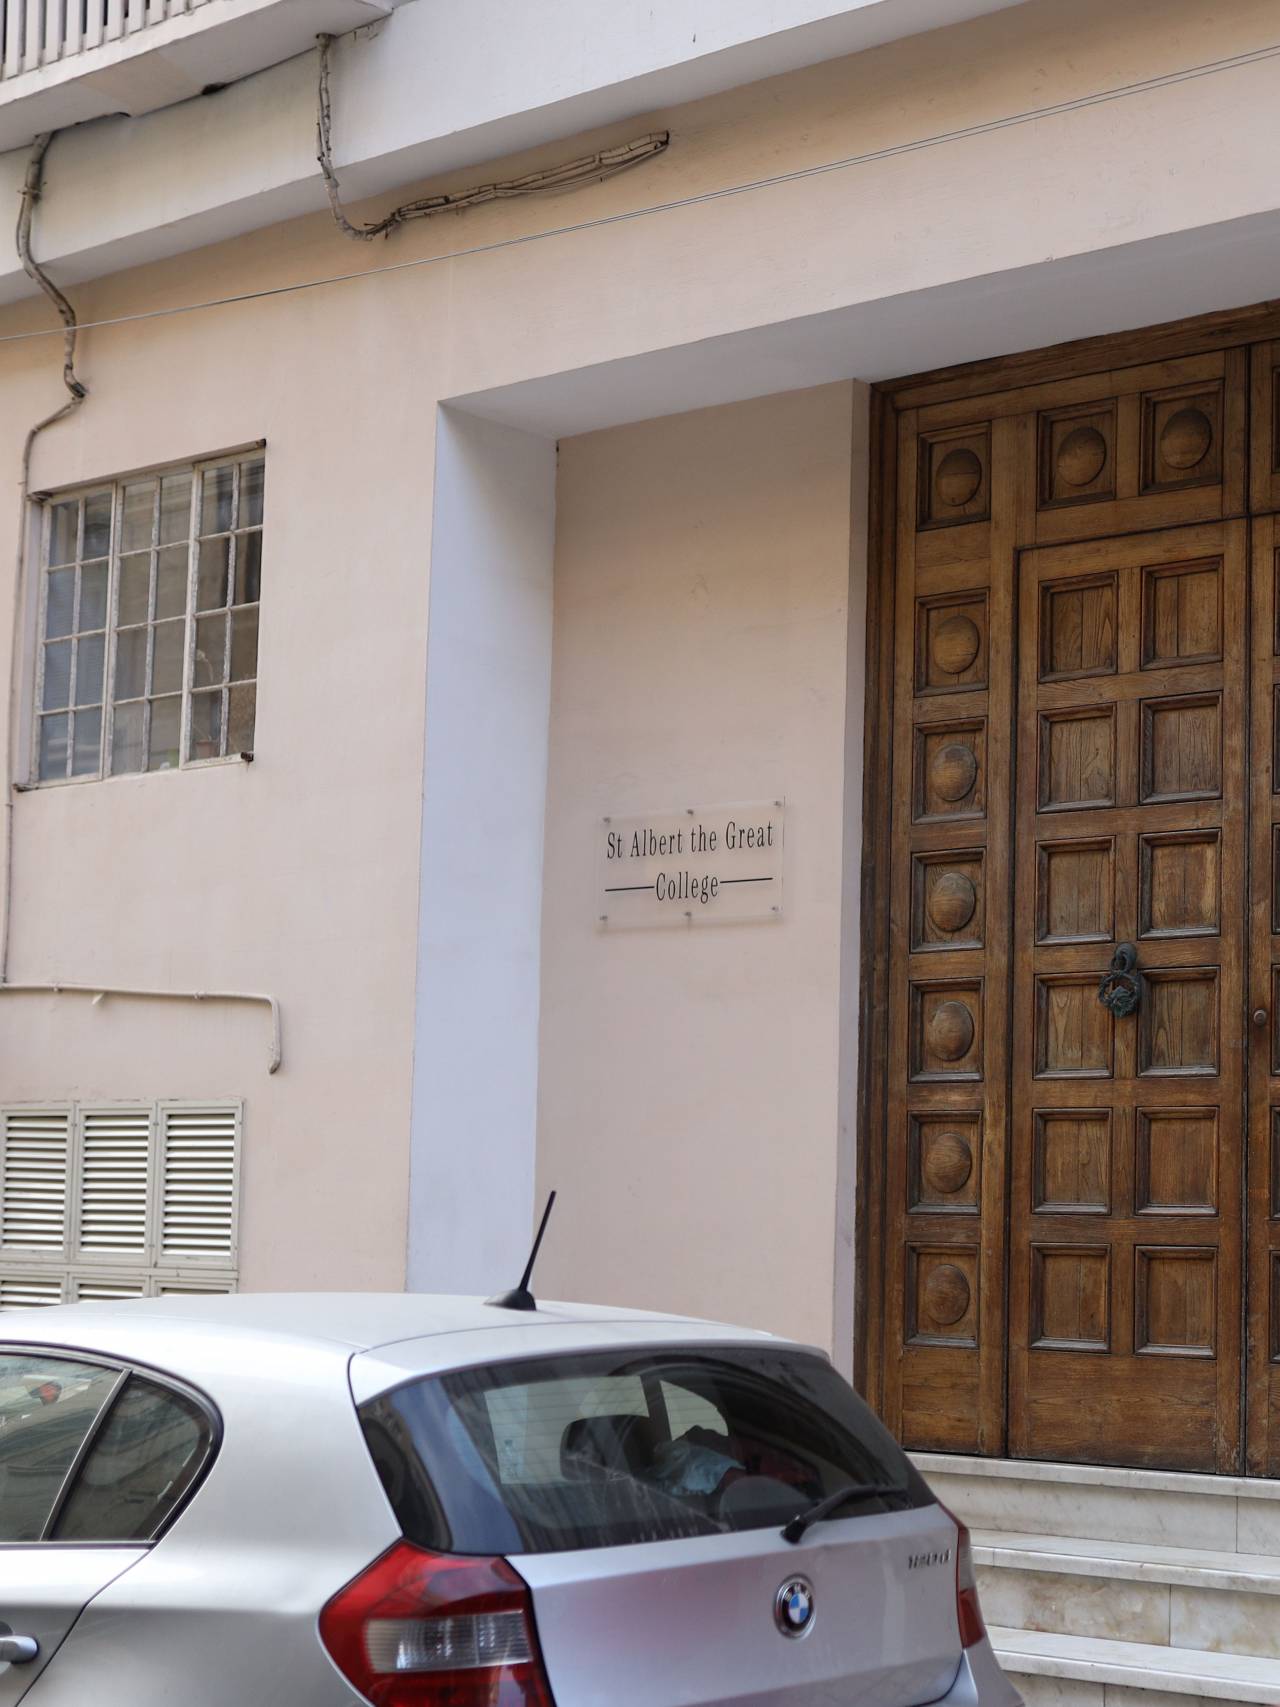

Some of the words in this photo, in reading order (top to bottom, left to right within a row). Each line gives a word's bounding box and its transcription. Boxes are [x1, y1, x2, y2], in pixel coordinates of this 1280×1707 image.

[607, 831, 622, 859] St
[630, 828, 683, 858] Albert
[690, 824, 717, 853] the
[725, 820, 774, 850] Great
[655, 871, 719, 905] College
